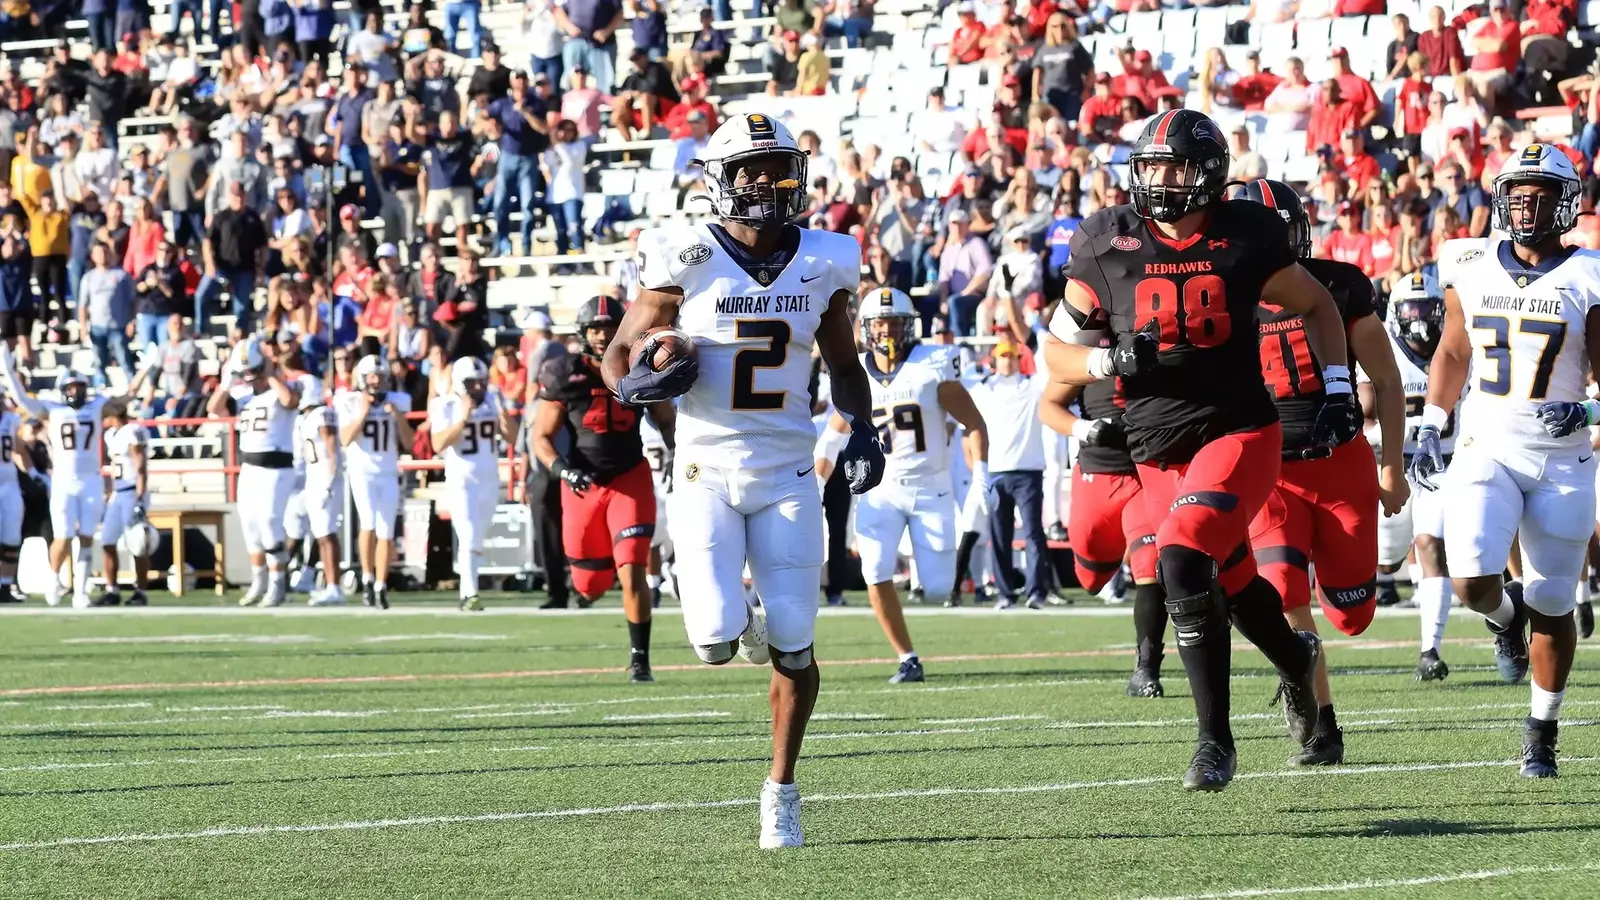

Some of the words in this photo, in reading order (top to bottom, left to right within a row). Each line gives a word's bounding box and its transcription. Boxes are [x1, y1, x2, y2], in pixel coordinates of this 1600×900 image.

[1145, 261, 1212, 274] REDHAWKS
[715, 296, 771, 314] MURRAY
[775, 294, 810, 313] STATE
[1135, 275, 1231, 351] 88
[1481, 295, 1525, 311] MURRAY
[1528, 298, 1561, 315] STATE
[1259, 318, 1303, 333] EDHAWKS
[731, 318, 792, 411] 2
[1259, 329, 1321, 398] 41
[1472, 315, 1567, 401] 37
[61, 421, 95, 450] 87
[362, 420, 389, 451] 91
[461, 421, 495, 455] 39
[1169, 495, 1198, 513] SEMO
[1337, 588, 1366, 603] SEMO
